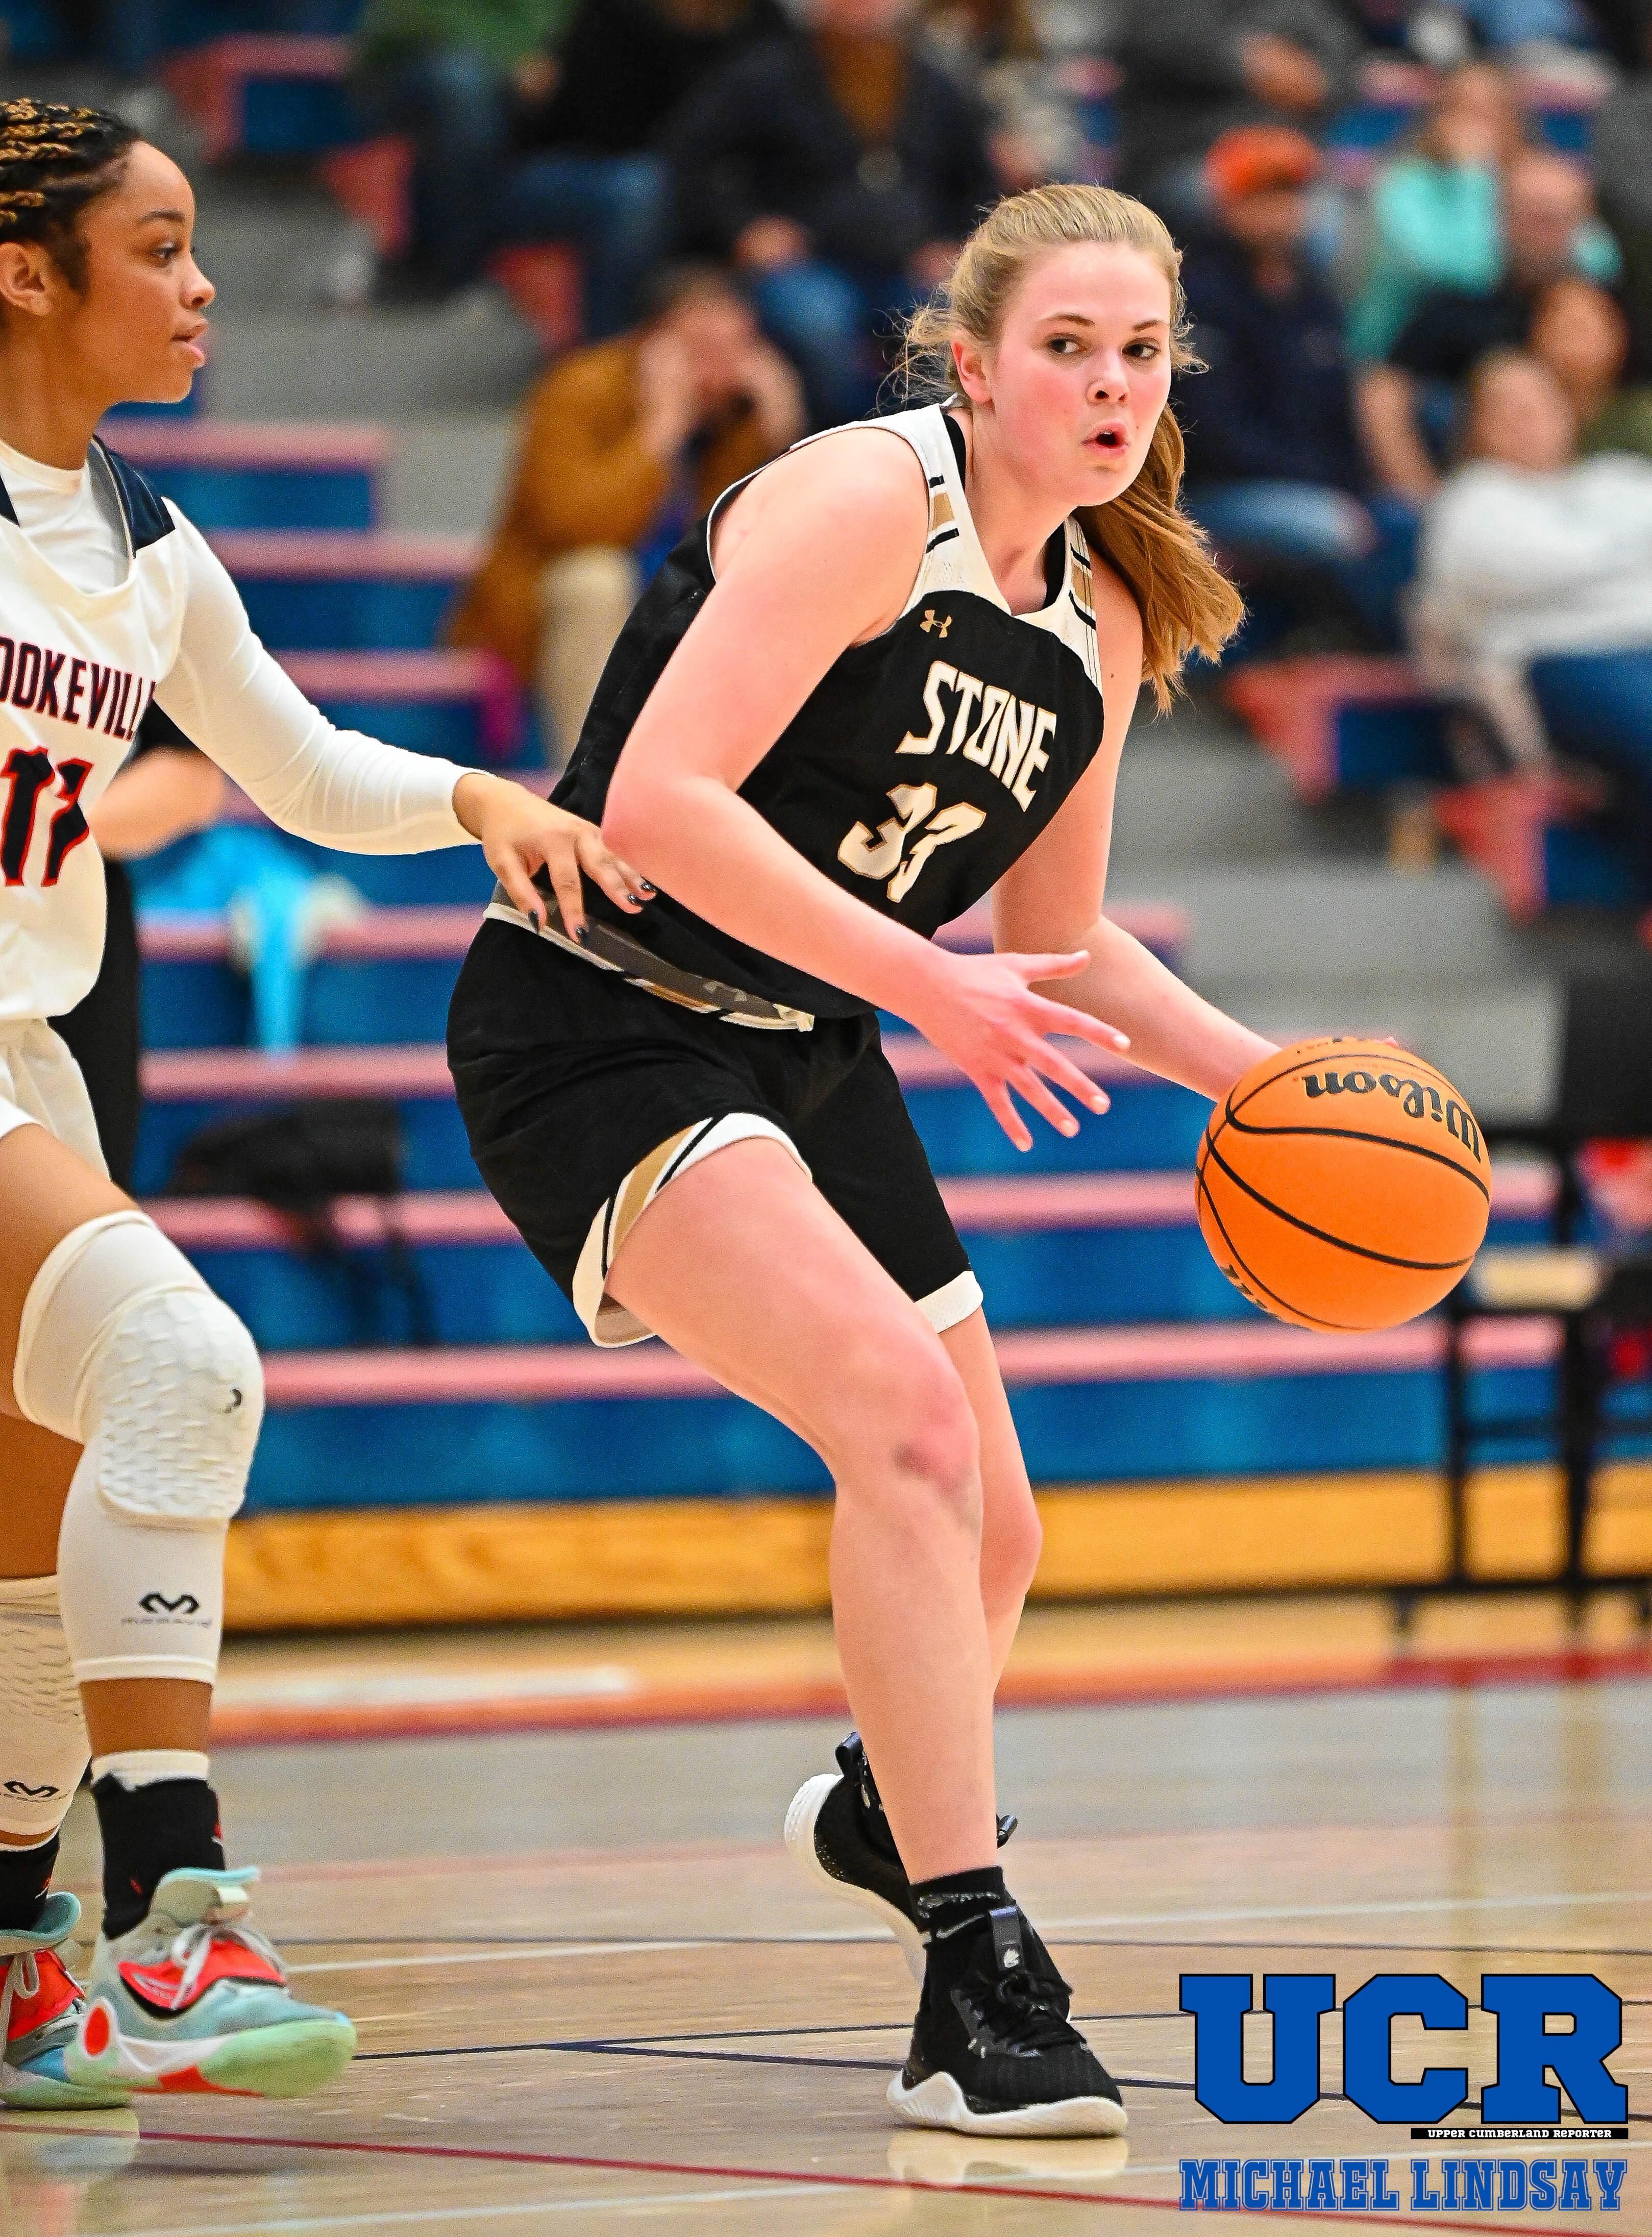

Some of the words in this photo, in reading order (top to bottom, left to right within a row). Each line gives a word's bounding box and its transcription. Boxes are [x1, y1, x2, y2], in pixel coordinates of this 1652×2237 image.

[0, 635, 156, 741] OOKEVILL
[895, 660, 1057, 813] STONE
[837, 782, 987, 903] 33
[1302, 1071, 1481, 1163] Wilson
